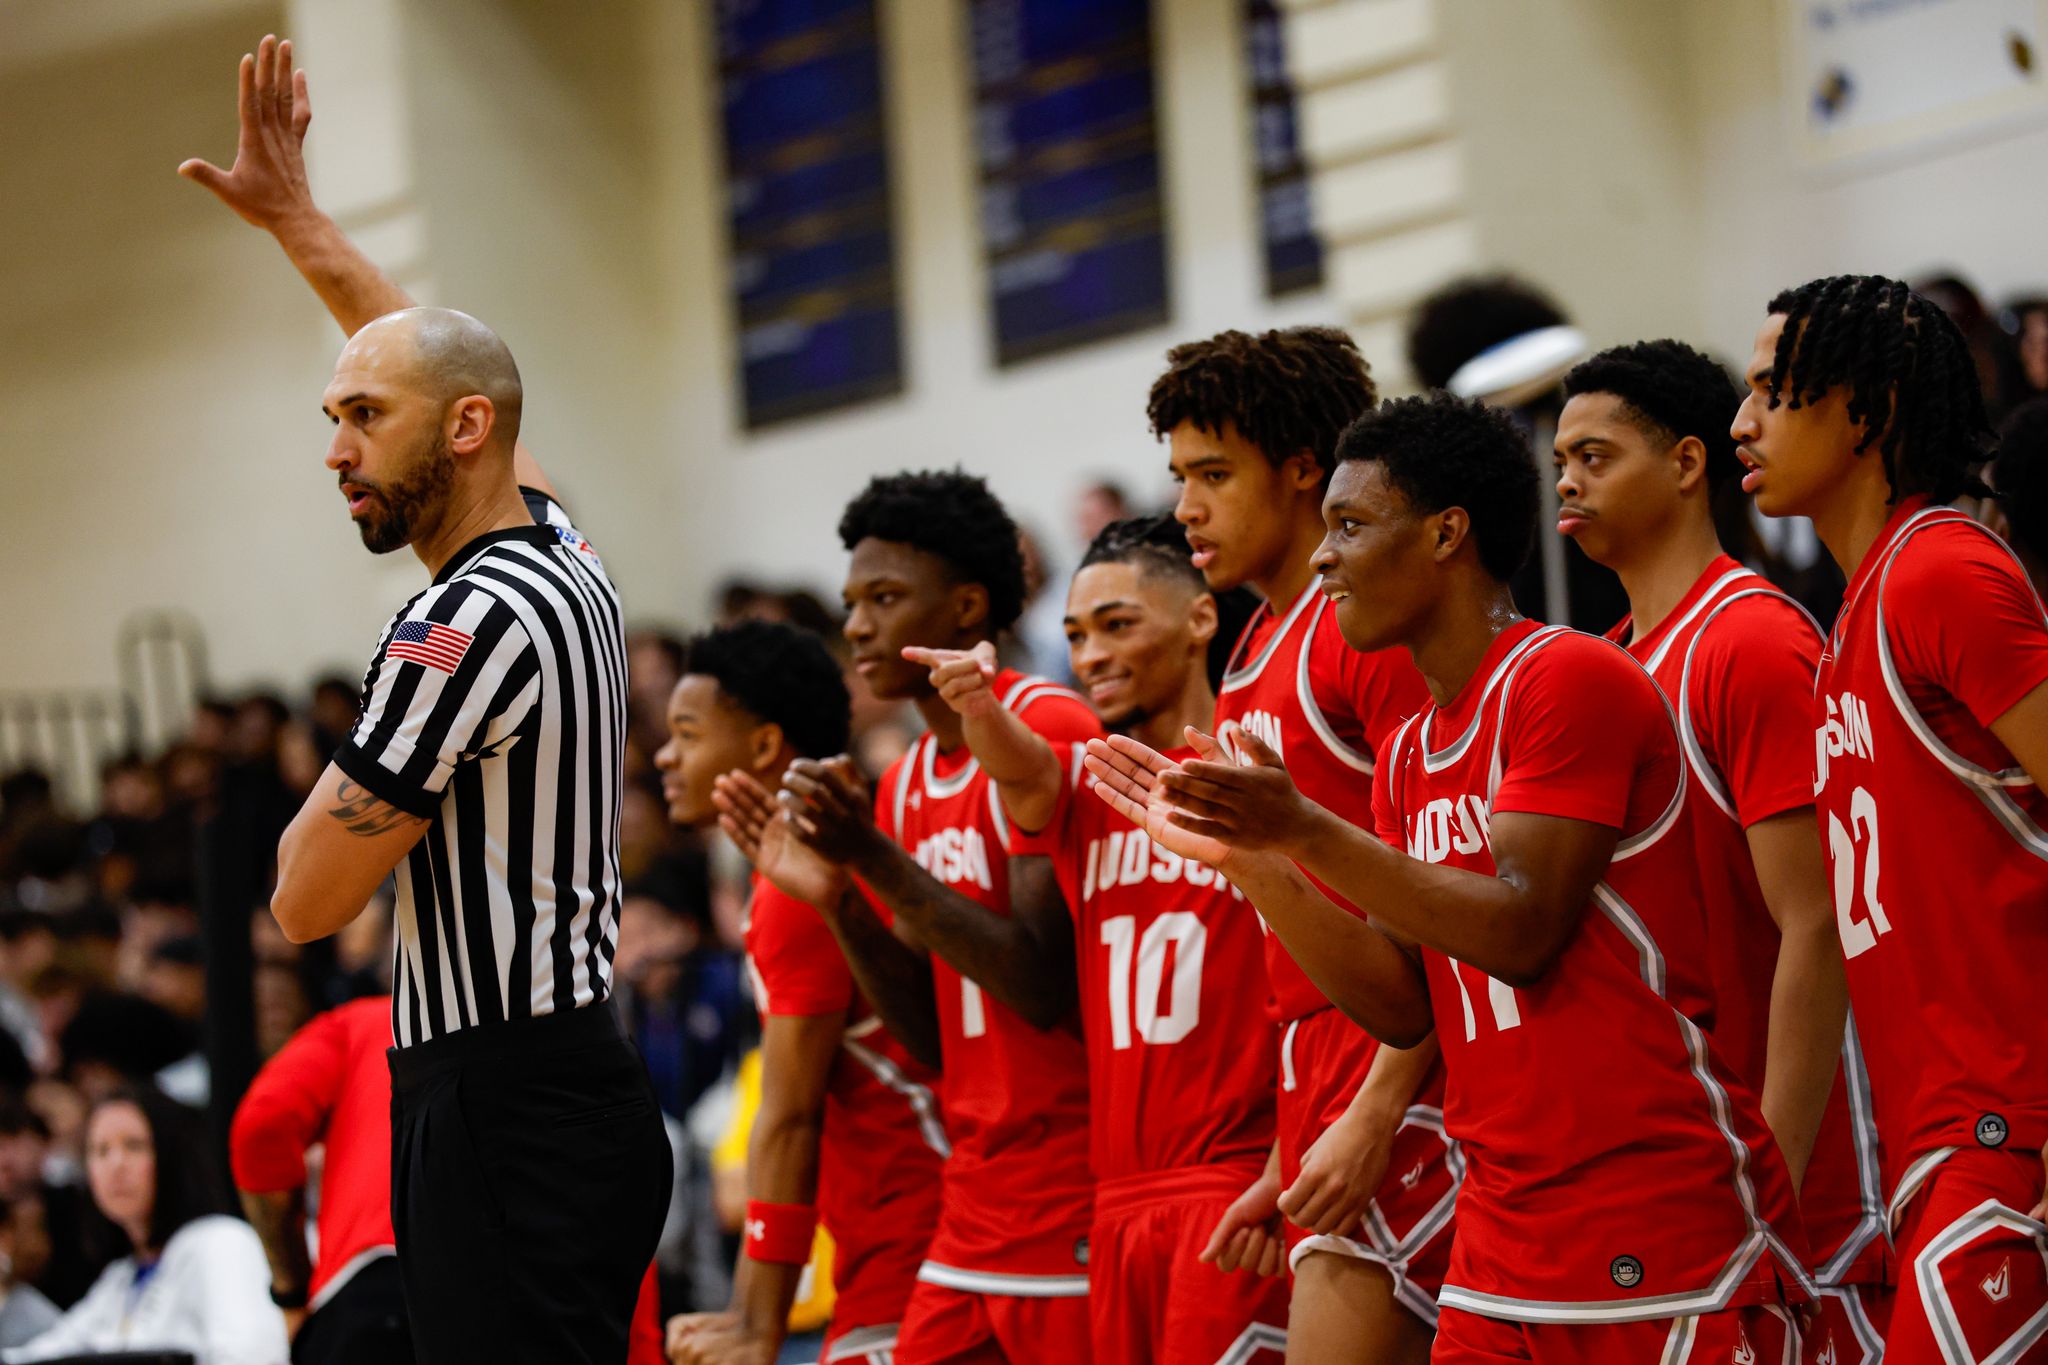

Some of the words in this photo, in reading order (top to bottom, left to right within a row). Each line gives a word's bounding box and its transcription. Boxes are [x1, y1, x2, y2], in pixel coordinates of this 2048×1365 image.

[1083, 827, 1244, 902] JUDSO
[1828, 785, 1893, 960] 22
[1100, 910, 1208, 1051] 10
[1618, 1265, 1634, 1273] MD
